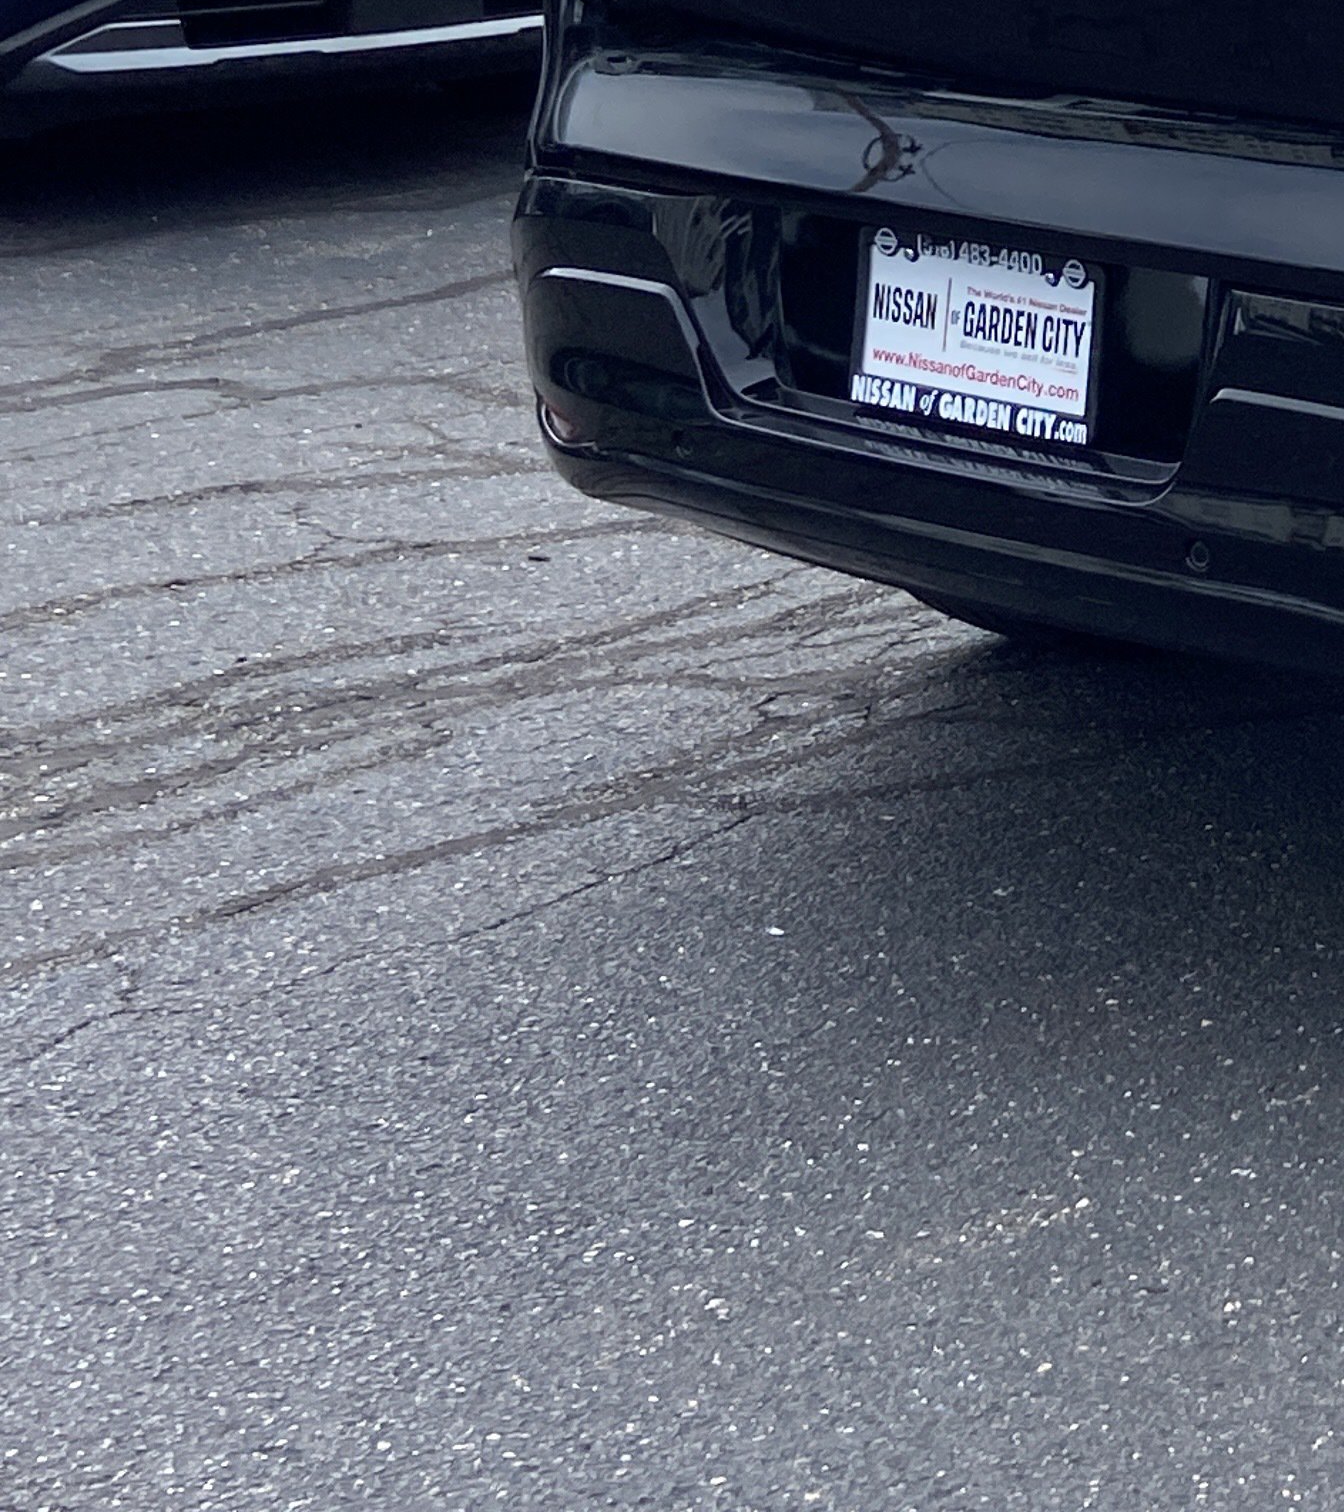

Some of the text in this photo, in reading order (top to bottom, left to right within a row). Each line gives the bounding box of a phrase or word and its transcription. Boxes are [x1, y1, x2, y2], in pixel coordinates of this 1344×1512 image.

[873, 282, 938, 330] NISSAN
[963, 301, 1037, 350] GARDEN
[1042, 316, 1087, 358] CITY
[873, 345, 1079, 402] www.NissanofGardenCity.com
[851, 374, 916, 413] NISSAN
[919, 390, 938, 416] of
[938, 392, 1012, 432] GARDEN
